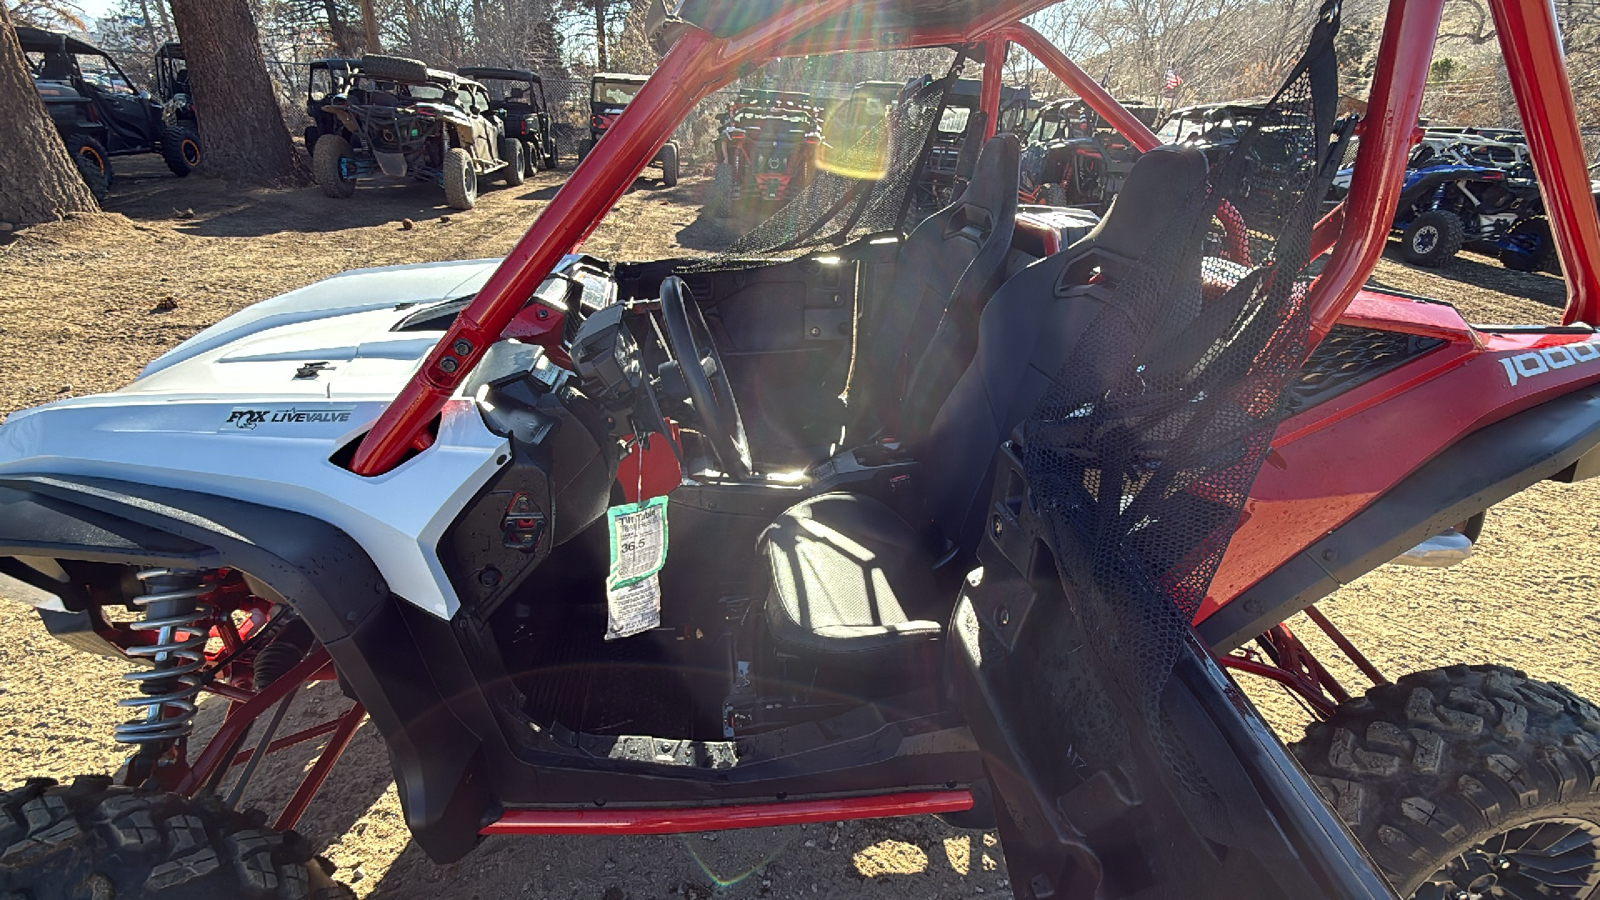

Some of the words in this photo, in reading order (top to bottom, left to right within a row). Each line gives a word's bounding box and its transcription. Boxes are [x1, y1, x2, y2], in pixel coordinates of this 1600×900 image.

[226, 410, 270, 426] FOX
[271, 412, 351, 422] LIVEVALVE
[621, 538, 645, 553] 36.5
